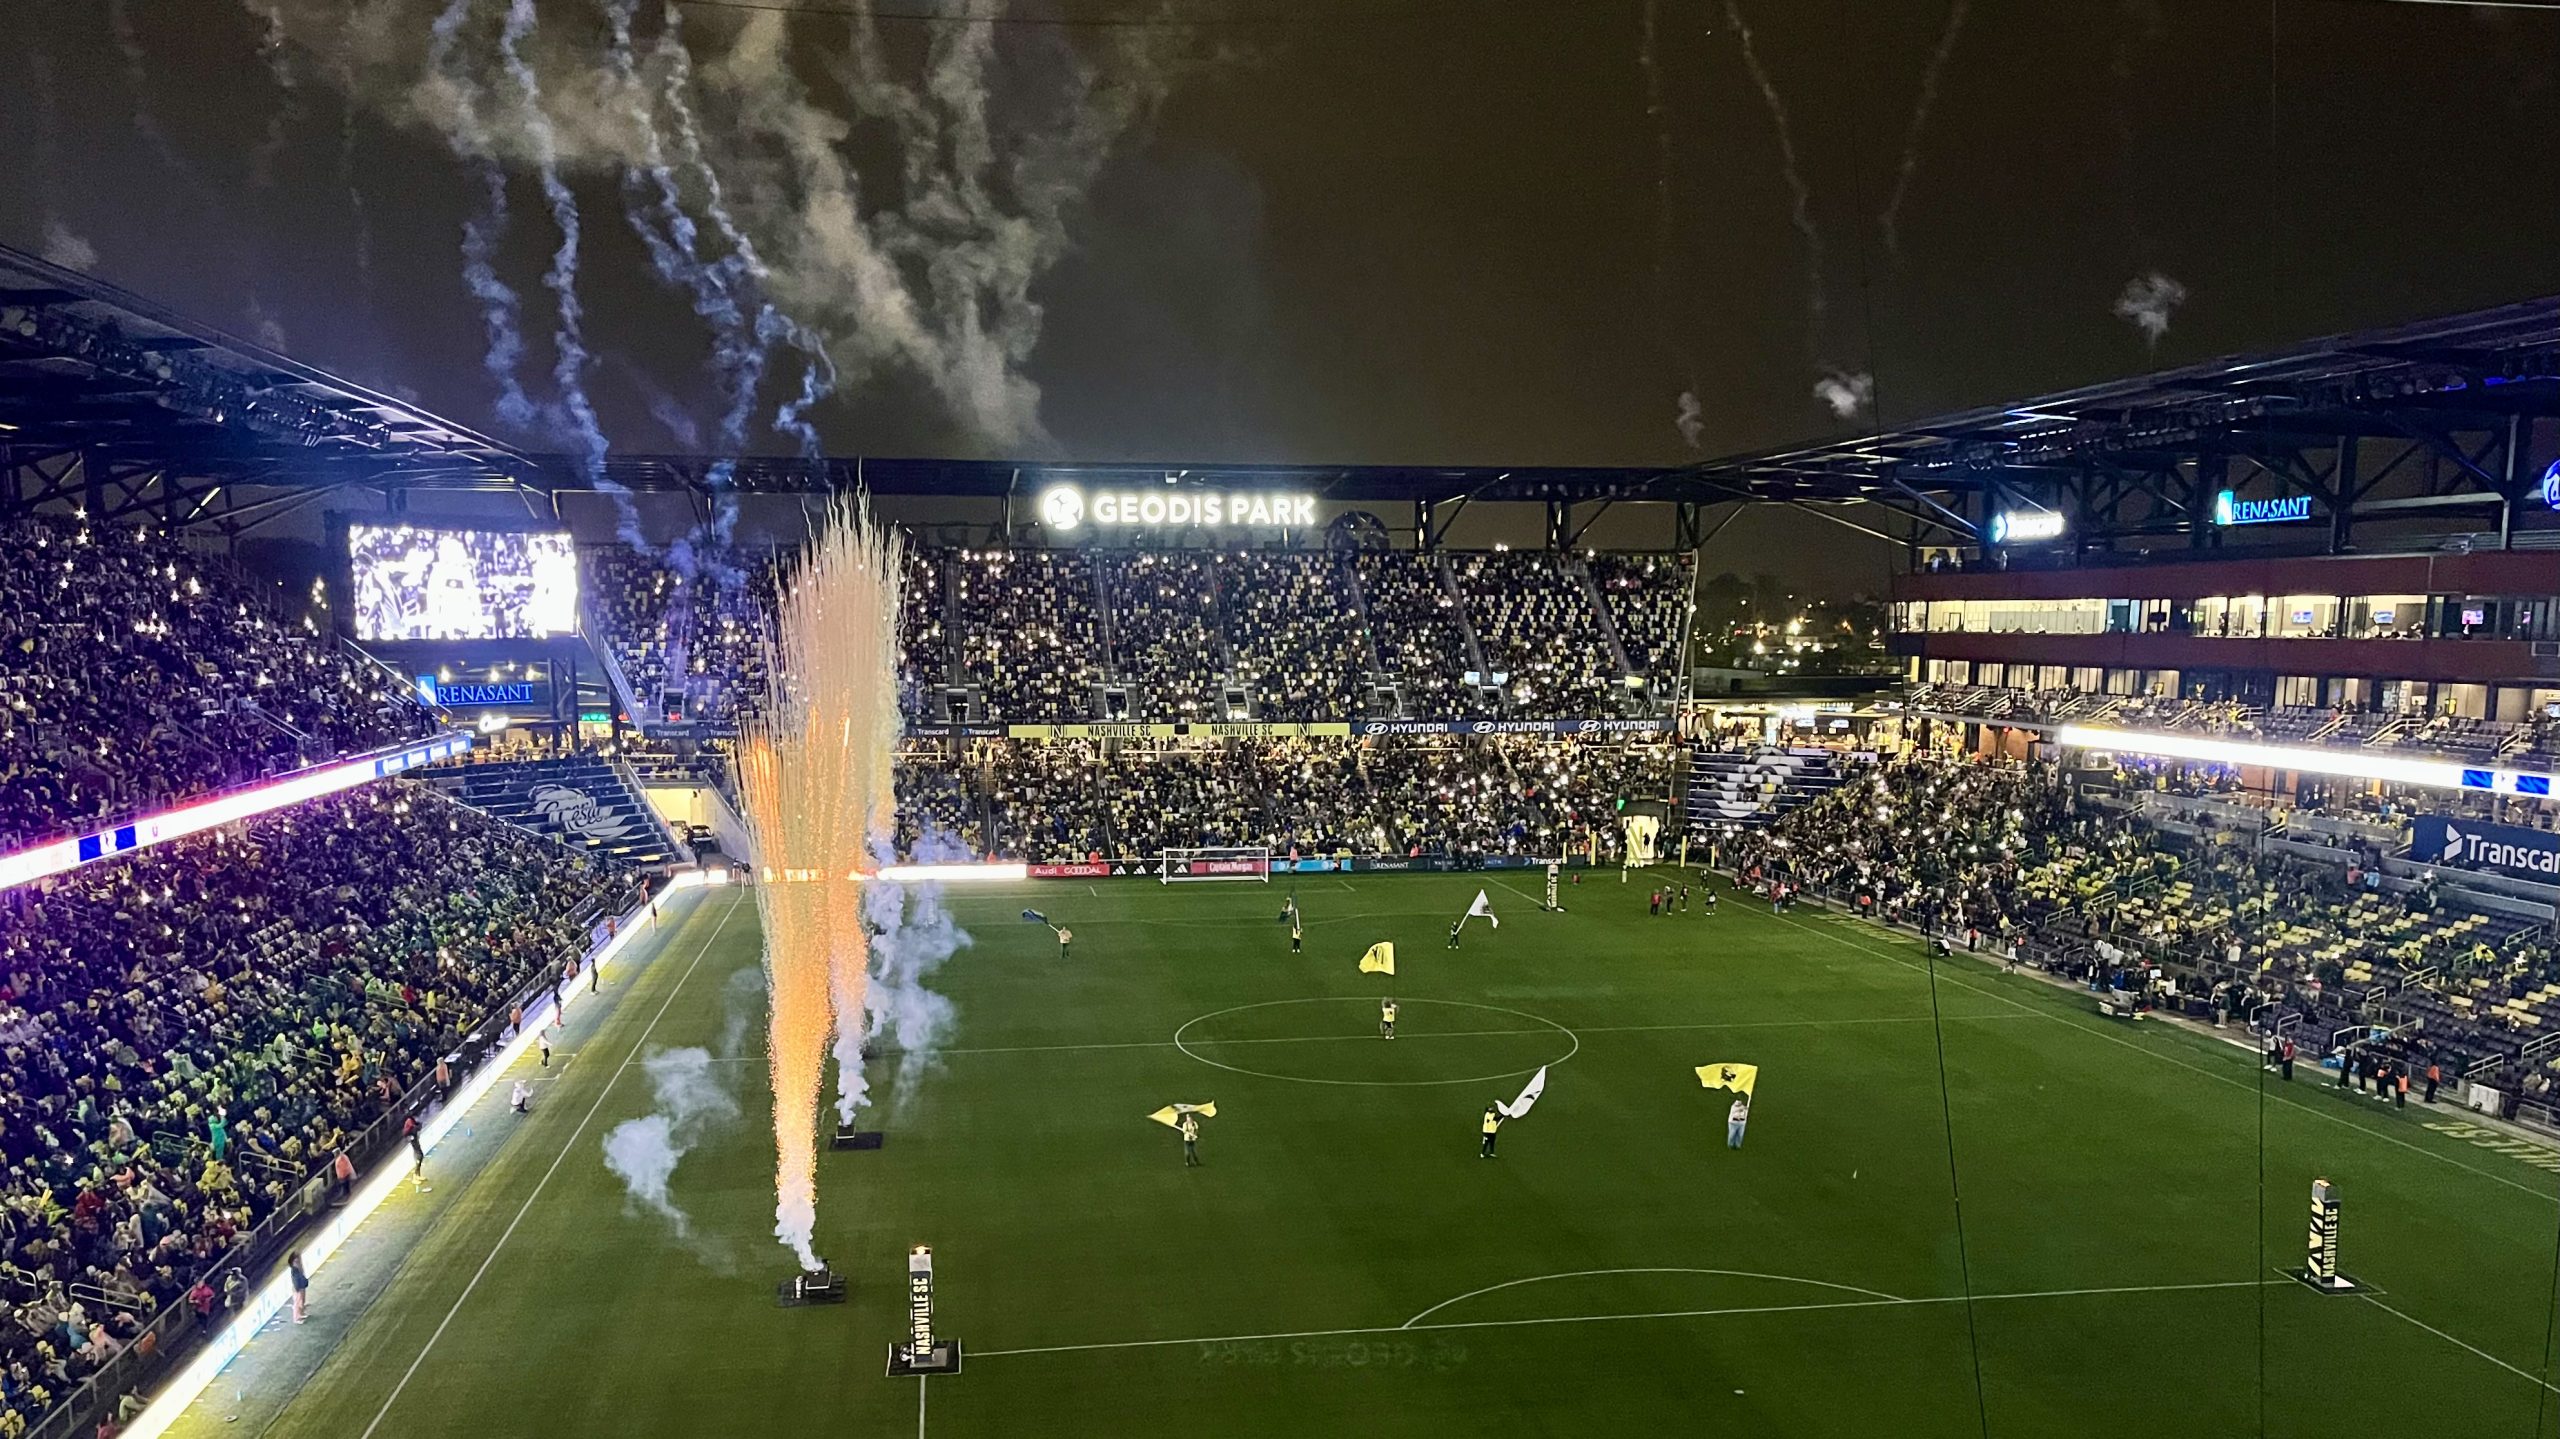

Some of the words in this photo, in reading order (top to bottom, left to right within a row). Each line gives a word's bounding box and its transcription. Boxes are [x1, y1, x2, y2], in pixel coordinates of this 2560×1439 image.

[1094, 495, 1222, 524] GEODIS
[1230, 495, 1315, 525] PARK
[2232, 496, 2311, 520] RENASANT
[437, 684, 533, 703] RENASANT
[917, 728, 950, 736] Transcard
[968, 728, 1000, 736] Transcard
[1088, 725, 1136, 737] NASHVILLE
[1140, 725, 1151, 737] SC
[1211, 724, 1258, 736] NASHVILLE
[1262, 724, 1273, 735] SC
[1390, 723, 1448, 734] HYUNDAI
[1497, 722, 1555, 732] HYUNDAI
[1603, 721, 1660, 731] HYUNDAI
[656, 729, 690, 737] Transcard
[1034, 867, 1057, 875] Audi
[2325, 1207, 2338, 1222] SC
[2322, 1222, 2338, 1278] NASHVILLE
[912, 1277, 929, 1293] SC
[913, 1293, 931, 1355] NASHVILLE
